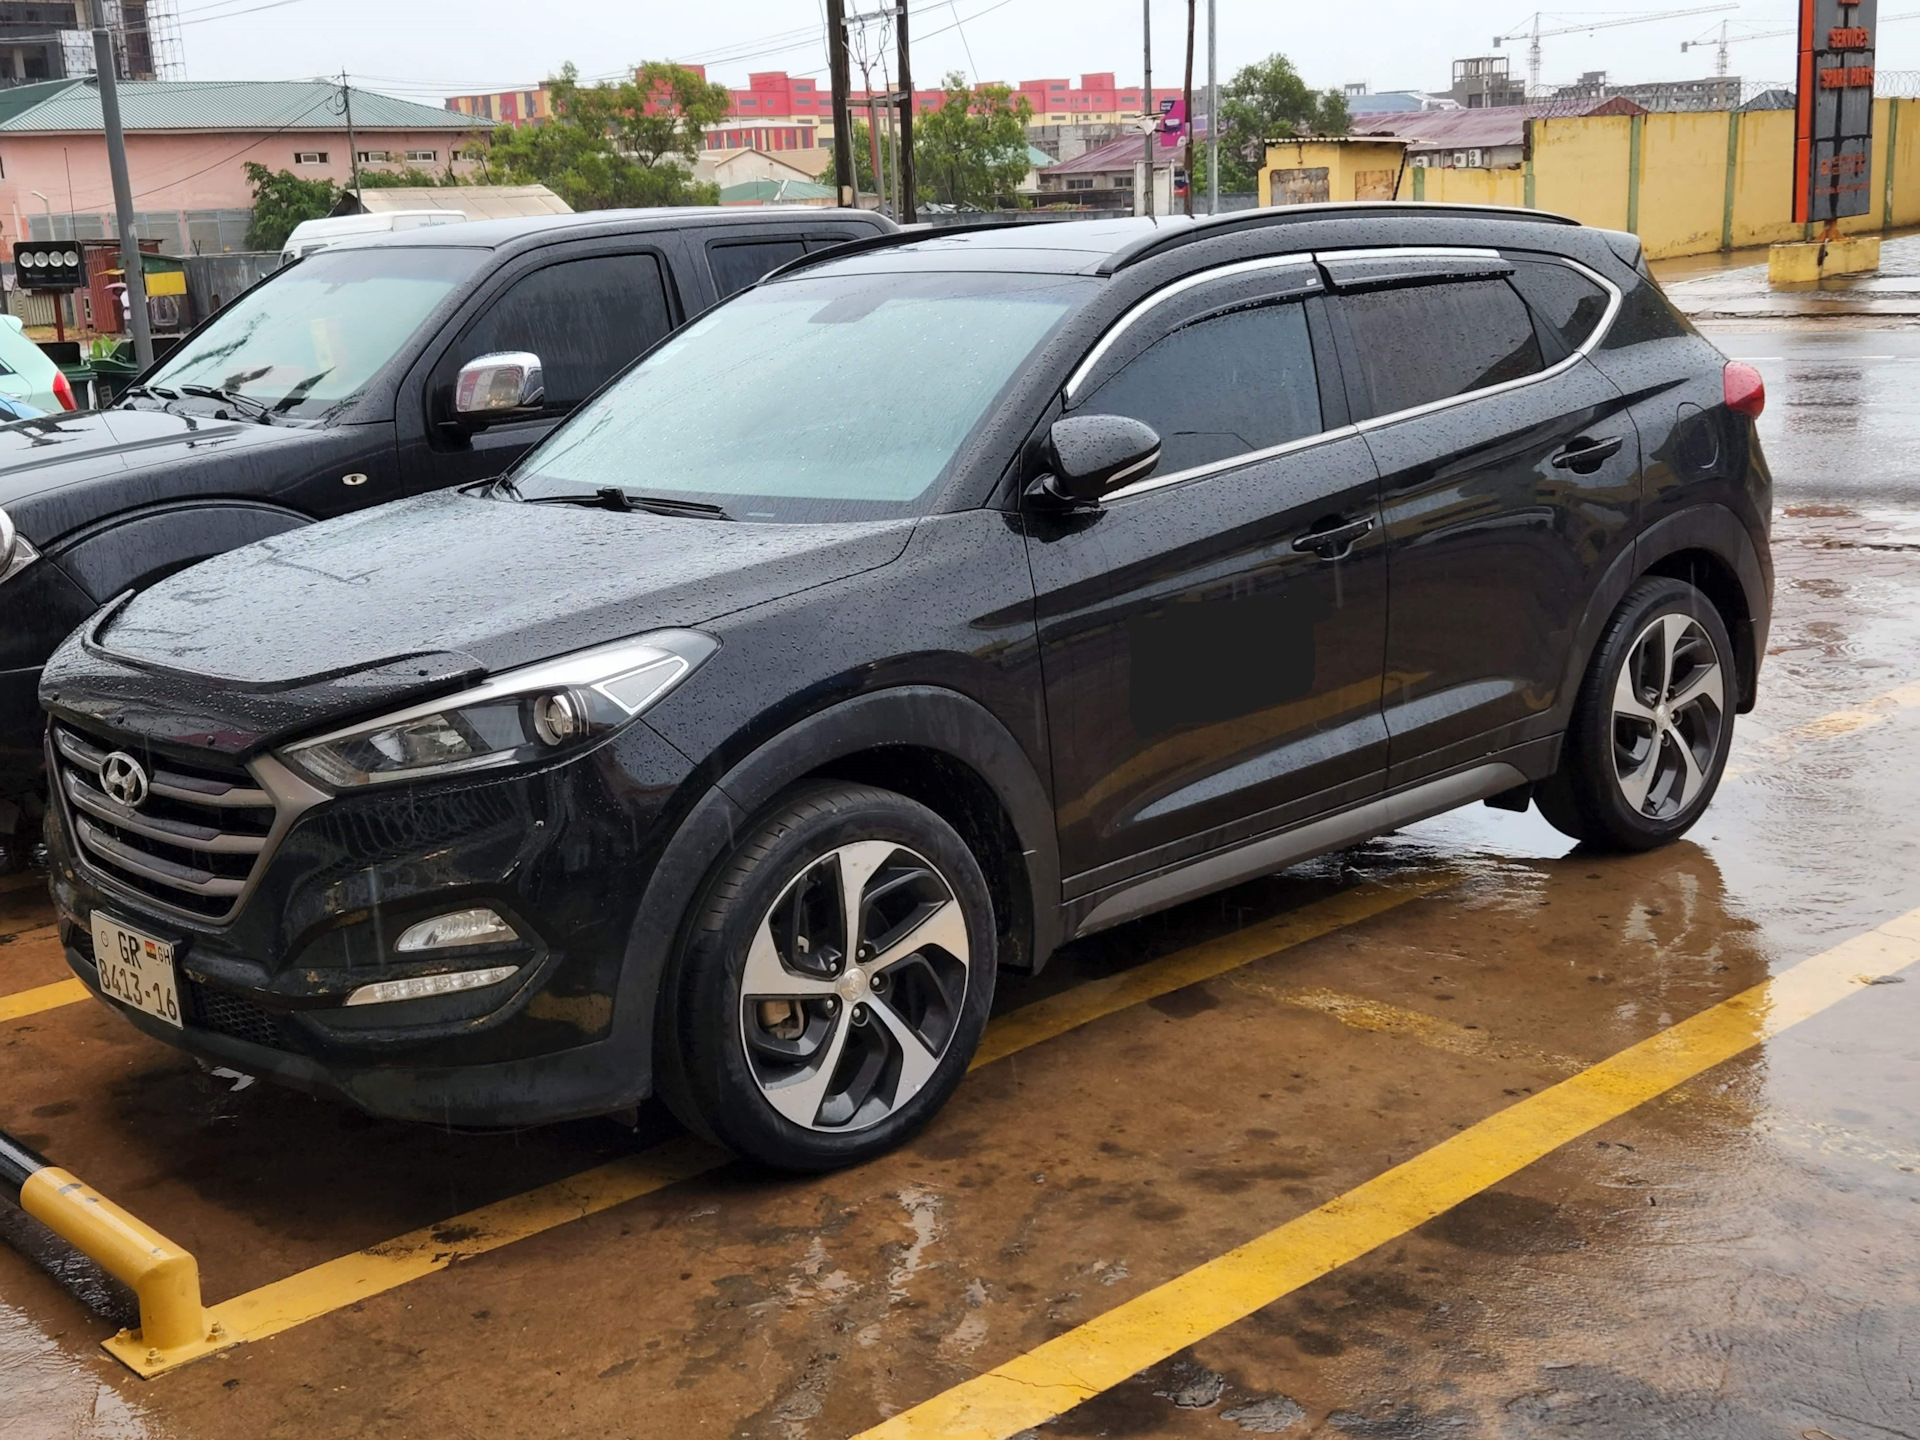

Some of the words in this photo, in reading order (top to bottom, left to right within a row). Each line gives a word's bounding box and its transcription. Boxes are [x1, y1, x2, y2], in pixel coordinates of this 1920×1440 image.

[1829, 27, 1870, 48] SERVICES
[1850, 65, 1874, 87] PARTS
[118, 931, 142, 970] GR
[157, 946, 171, 966] GH
[99, 958, 177, 1021] 8413-16
